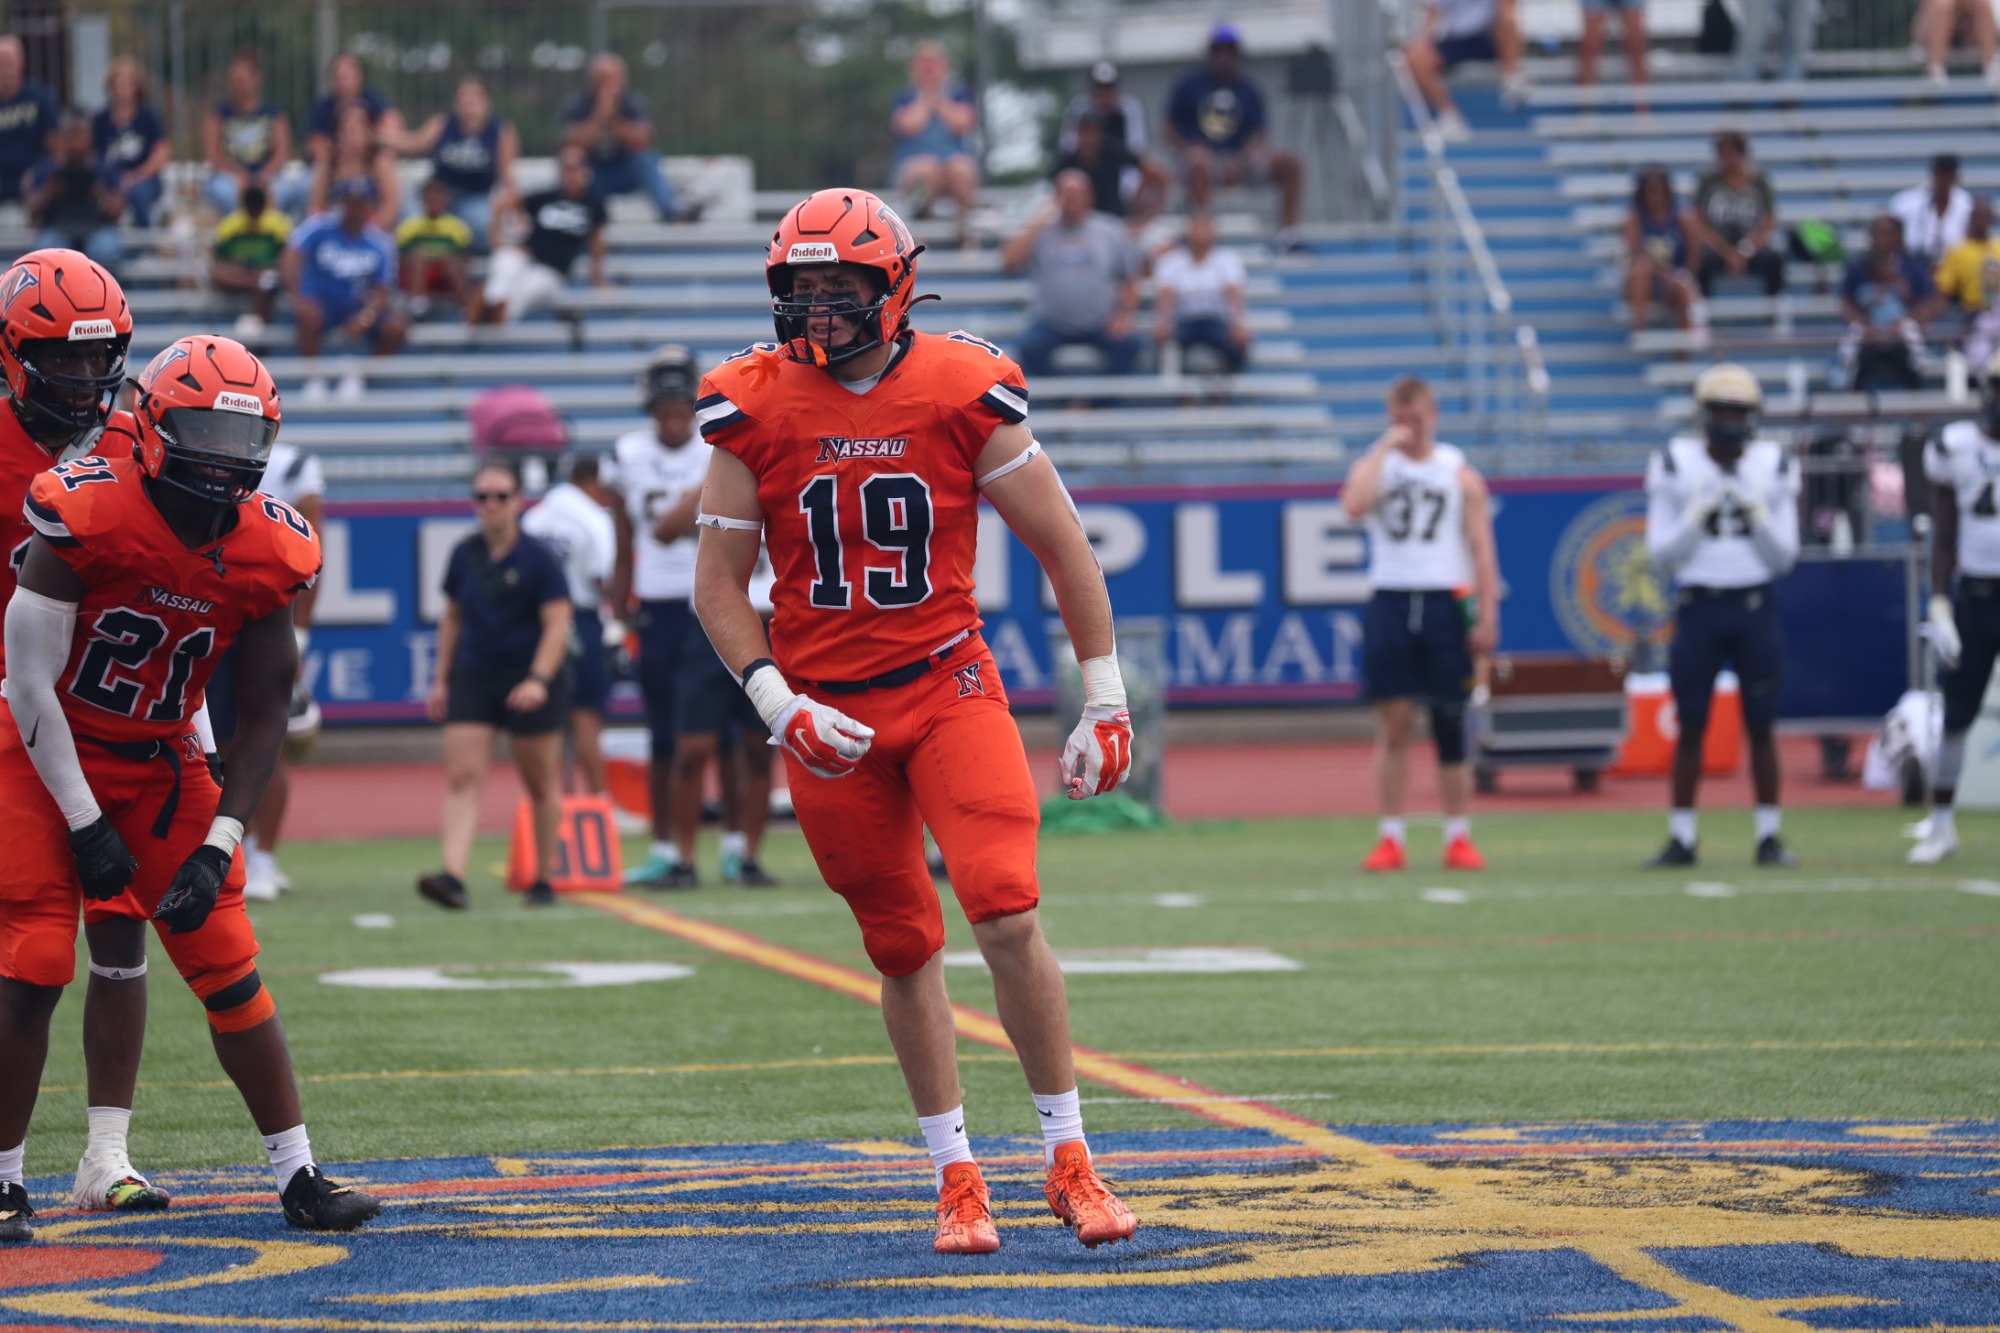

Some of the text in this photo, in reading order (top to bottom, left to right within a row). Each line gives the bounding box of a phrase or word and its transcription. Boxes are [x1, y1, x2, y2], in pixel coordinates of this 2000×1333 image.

[790, 247, 833, 258] Riddell
[74, 325, 113, 336] Riddell
[220, 395, 261, 411] Riddell
[816, 436, 908, 465] NASSAU
[48, 455, 119, 493] 21
[252, 494, 313, 543] 2
[798, 472, 935, 611] 19
[133, 585, 217, 617] NASSAU
[66, 606, 216, 721] 21
[952, 661, 985, 698] N
